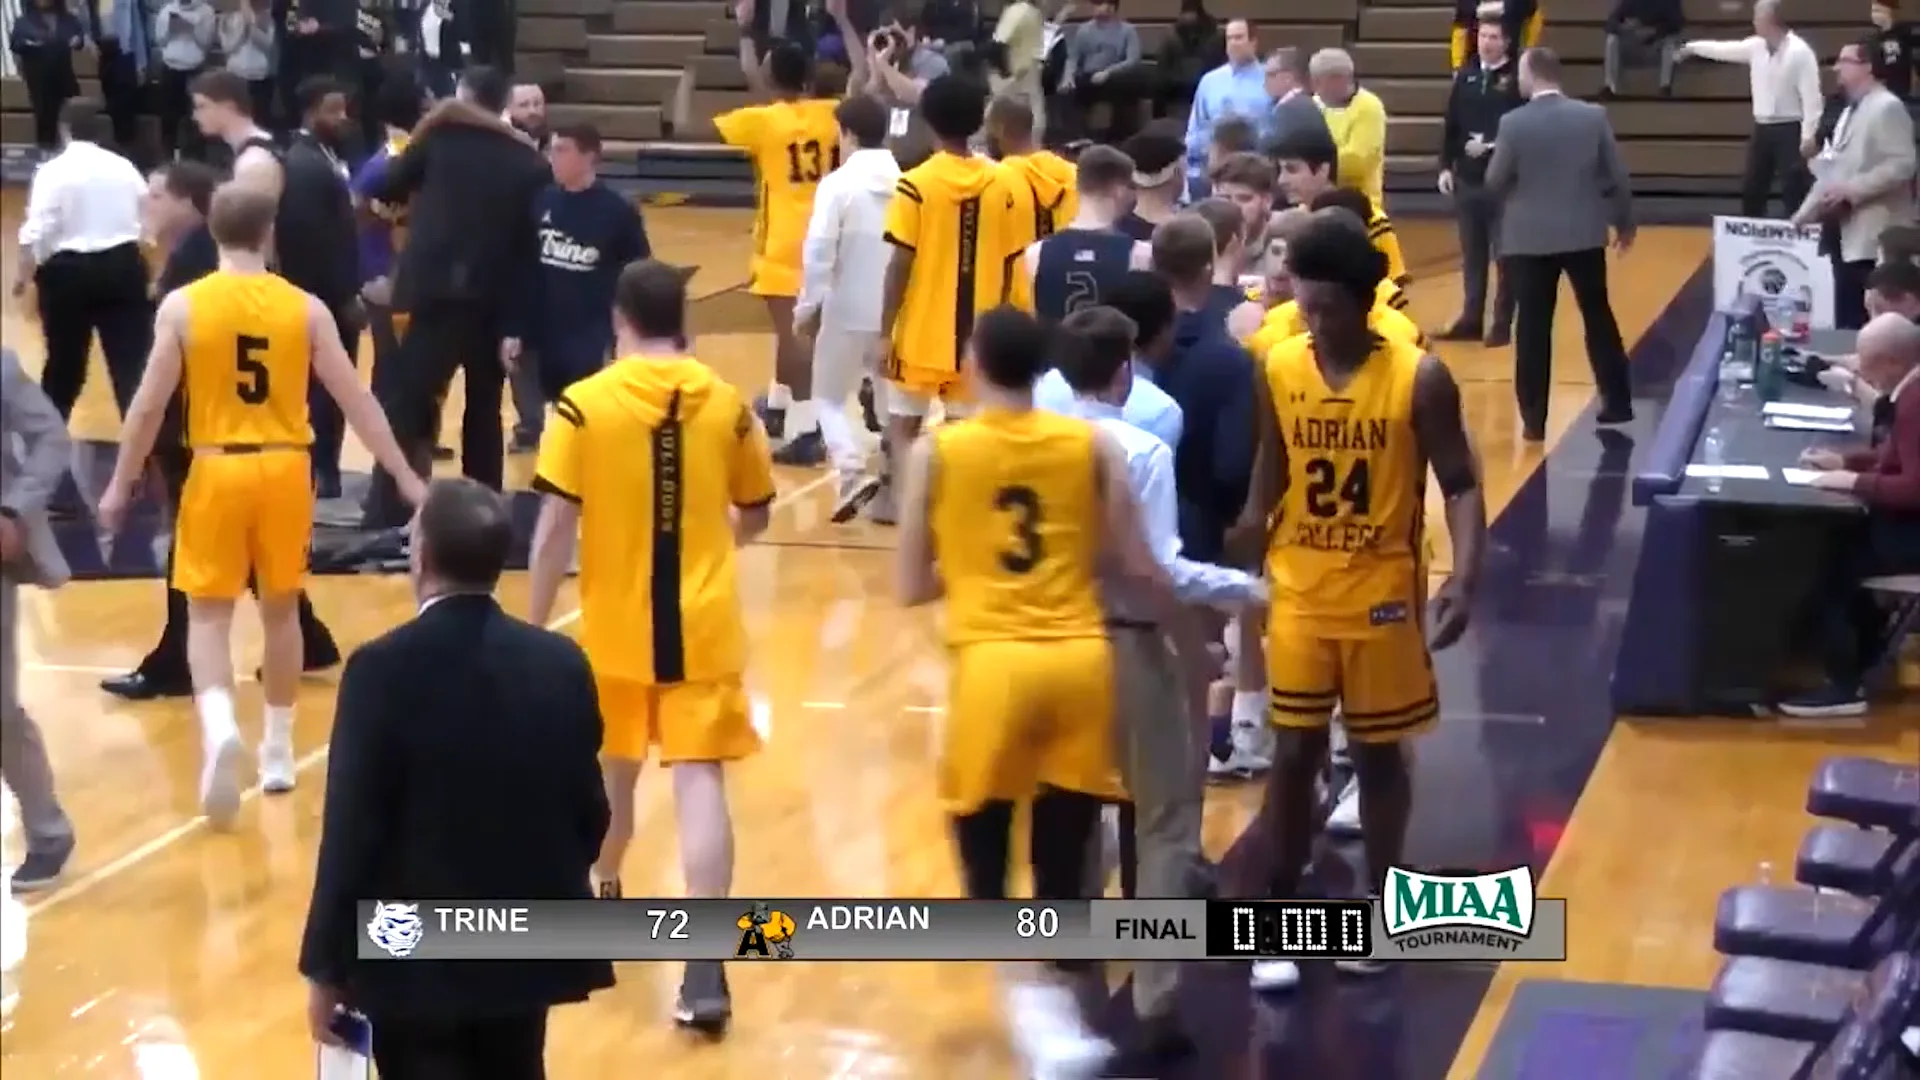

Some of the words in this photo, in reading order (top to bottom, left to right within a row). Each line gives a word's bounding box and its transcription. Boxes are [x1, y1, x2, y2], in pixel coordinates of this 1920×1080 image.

[1065, 271, 1099, 316] 2
[236, 333, 269, 405] 5
[1292, 416, 1388, 450] ADRIAN
[1306, 457, 1370, 518] 24
[992, 485, 1046, 575] 3
